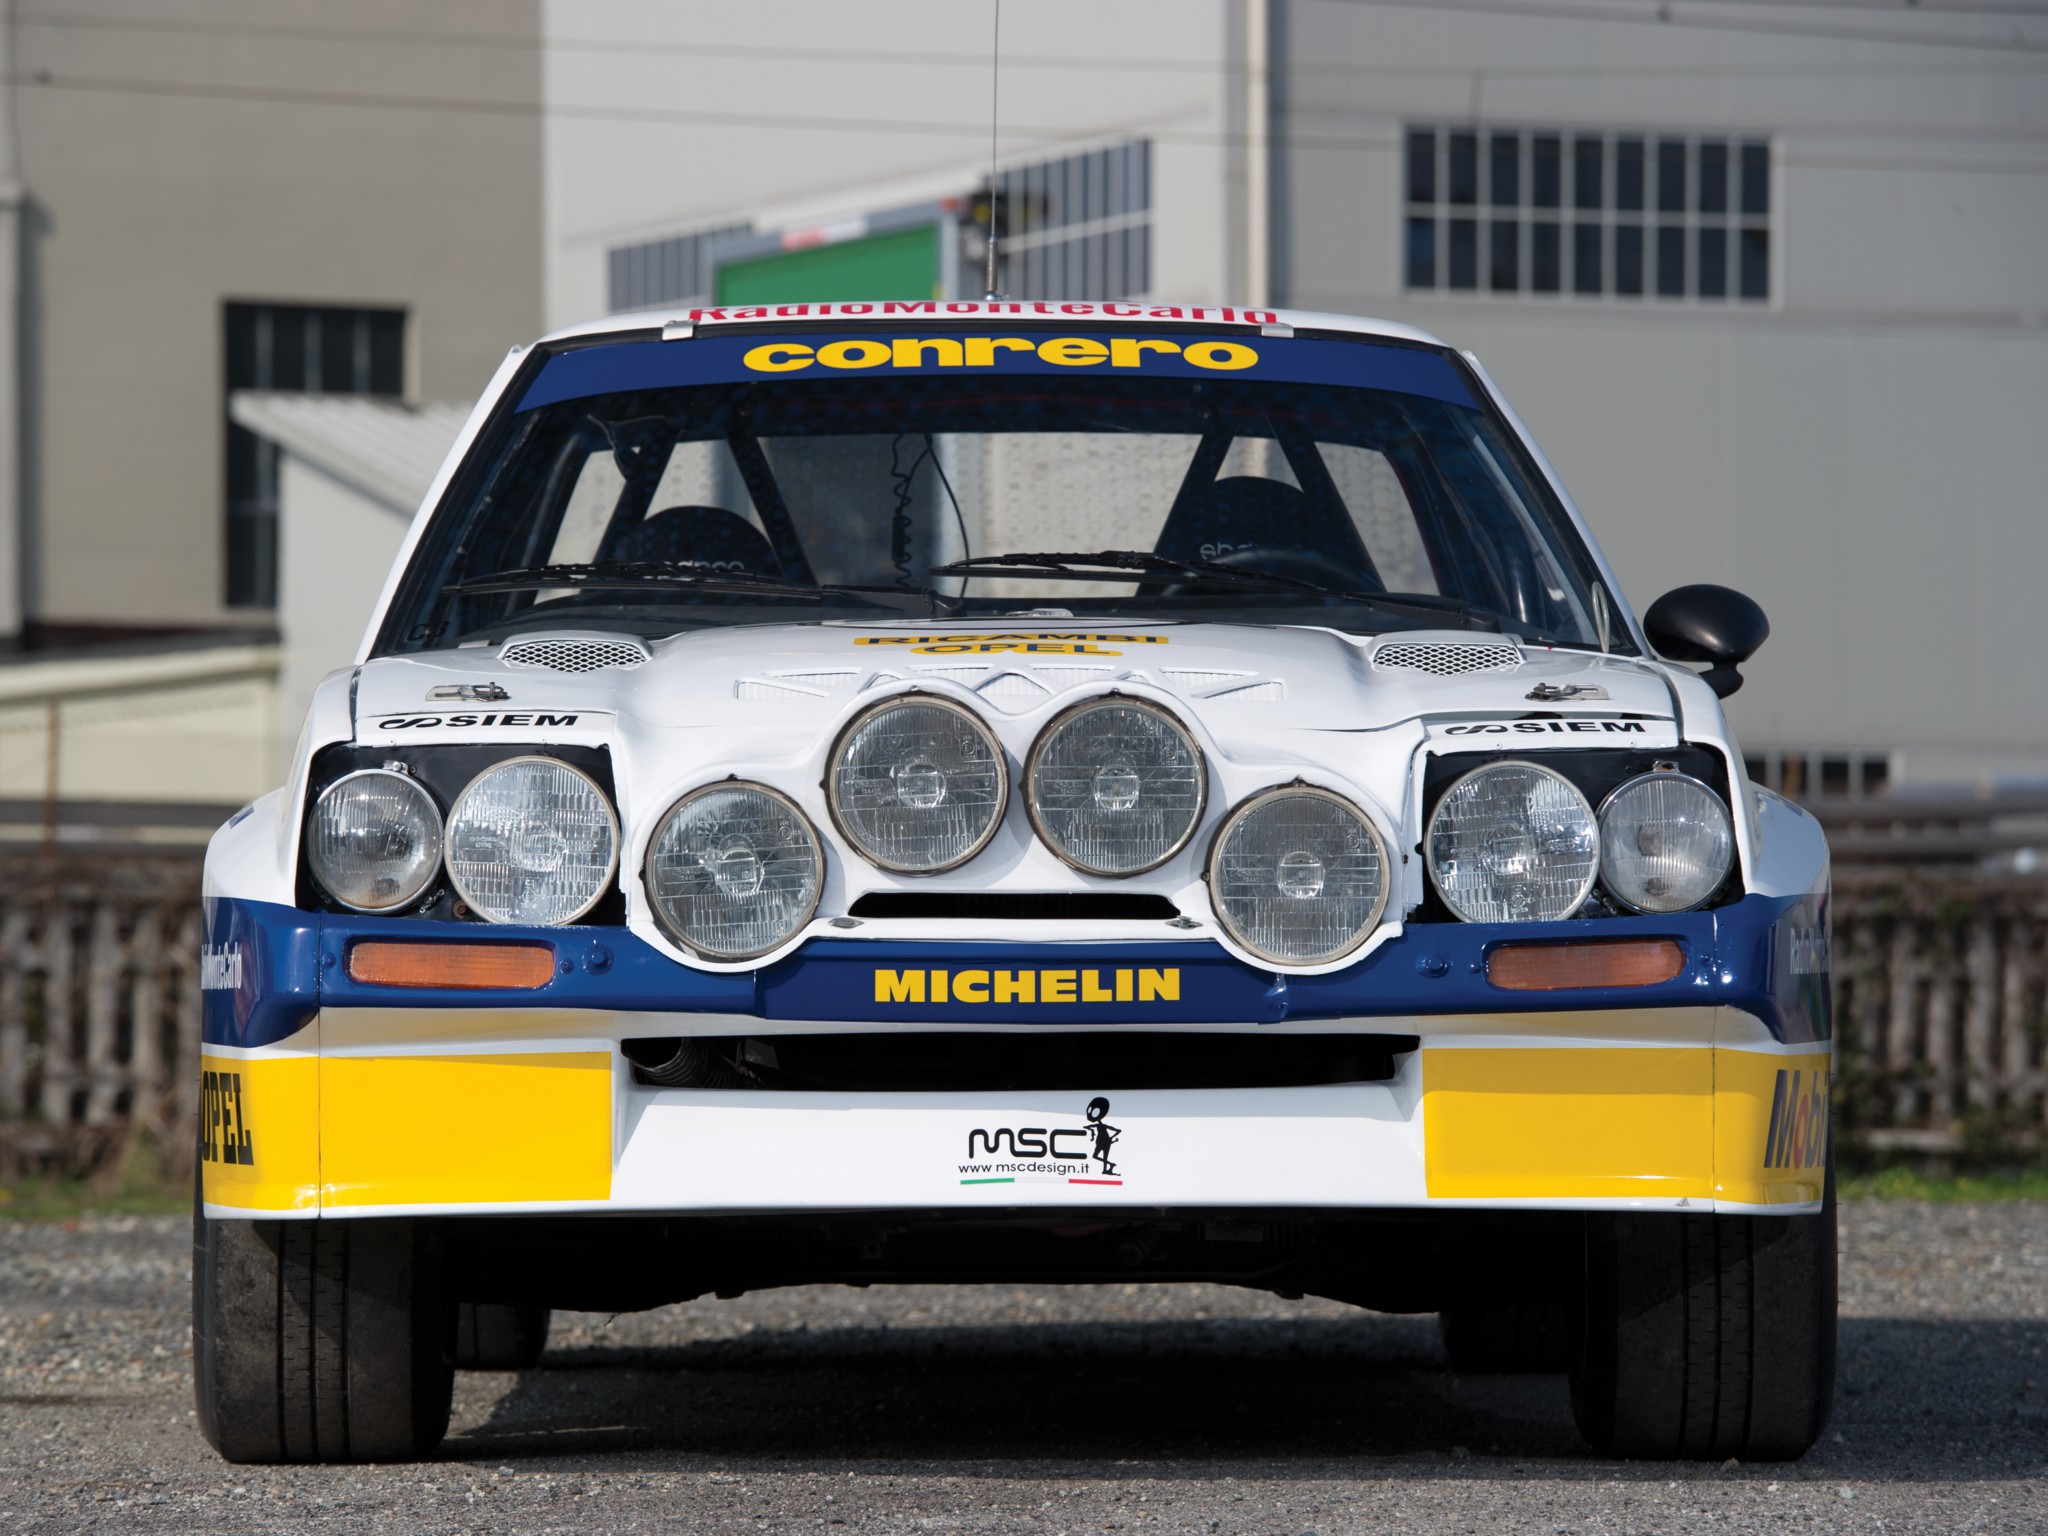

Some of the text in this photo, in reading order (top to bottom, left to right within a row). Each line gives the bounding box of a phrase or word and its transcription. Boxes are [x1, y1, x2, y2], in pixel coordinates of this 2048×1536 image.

[743, 337, 1259, 372] conrero
[867, 634, 1157, 644] RICAMBI
[923, 644, 1110, 654] OPEL
[446, 714, 579, 727] SIEM
[1513, 722, 1646, 733] SIEM
[875, 968, 1180, 1002] MICHELIN
[202, 1070, 254, 1166] OPEL
